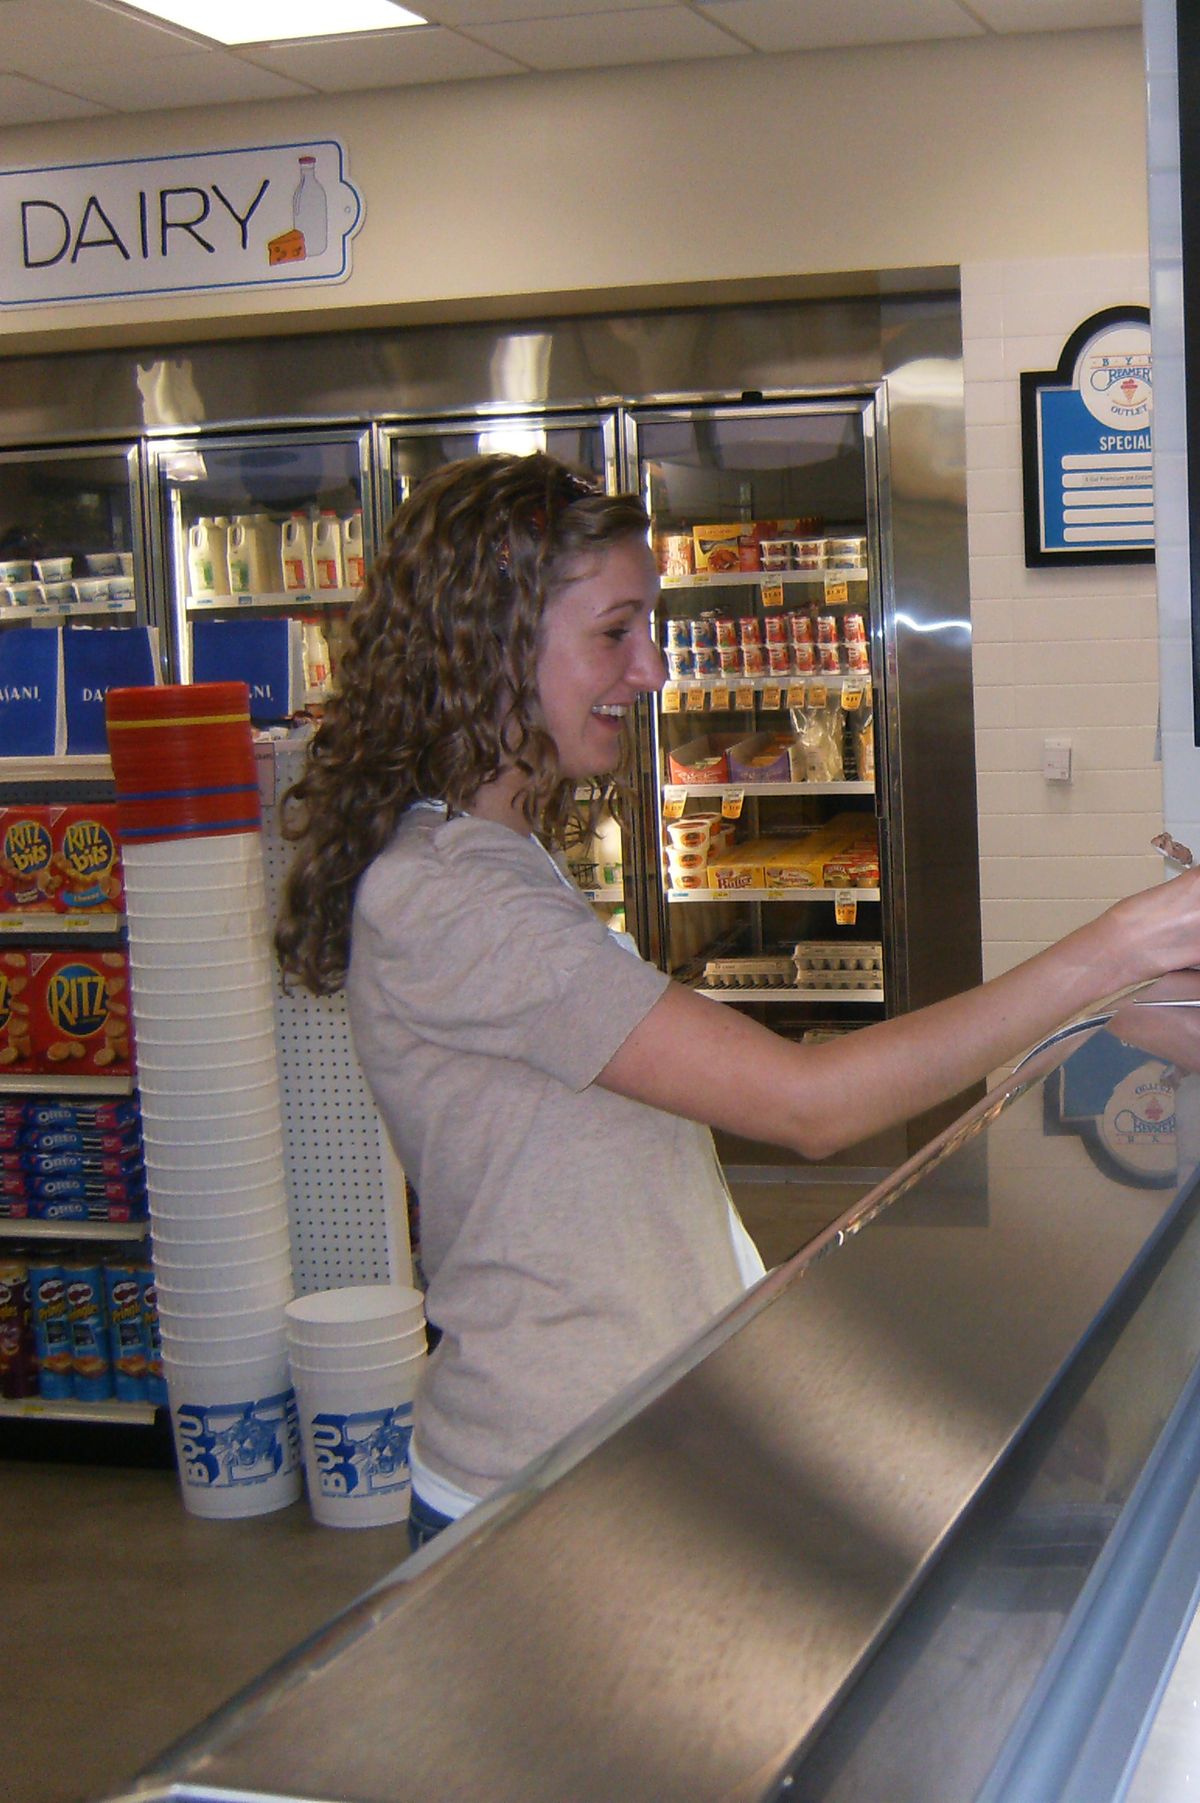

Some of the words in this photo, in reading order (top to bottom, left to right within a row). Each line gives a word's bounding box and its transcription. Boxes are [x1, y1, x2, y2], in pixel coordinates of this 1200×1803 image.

[21, 179, 270, 269] DAIRY
[1090, 368, 1152, 391] CREAMER
[1111, 404, 1148, 416] OUTLET
[1100, 435, 1151, 451] SPECIAL
[0, 684, 38, 702] SANI
[8, 823, 42, 849] RITZ
[66, 824, 103, 851] RITZ
[13, 845, 48, 871] bits
[71, 846, 108, 873] bits
[49, 975, 107, 1026] RITZ
[179, 1414, 208, 1484] BYU
[313, 1424, 348, 1494] BYU
